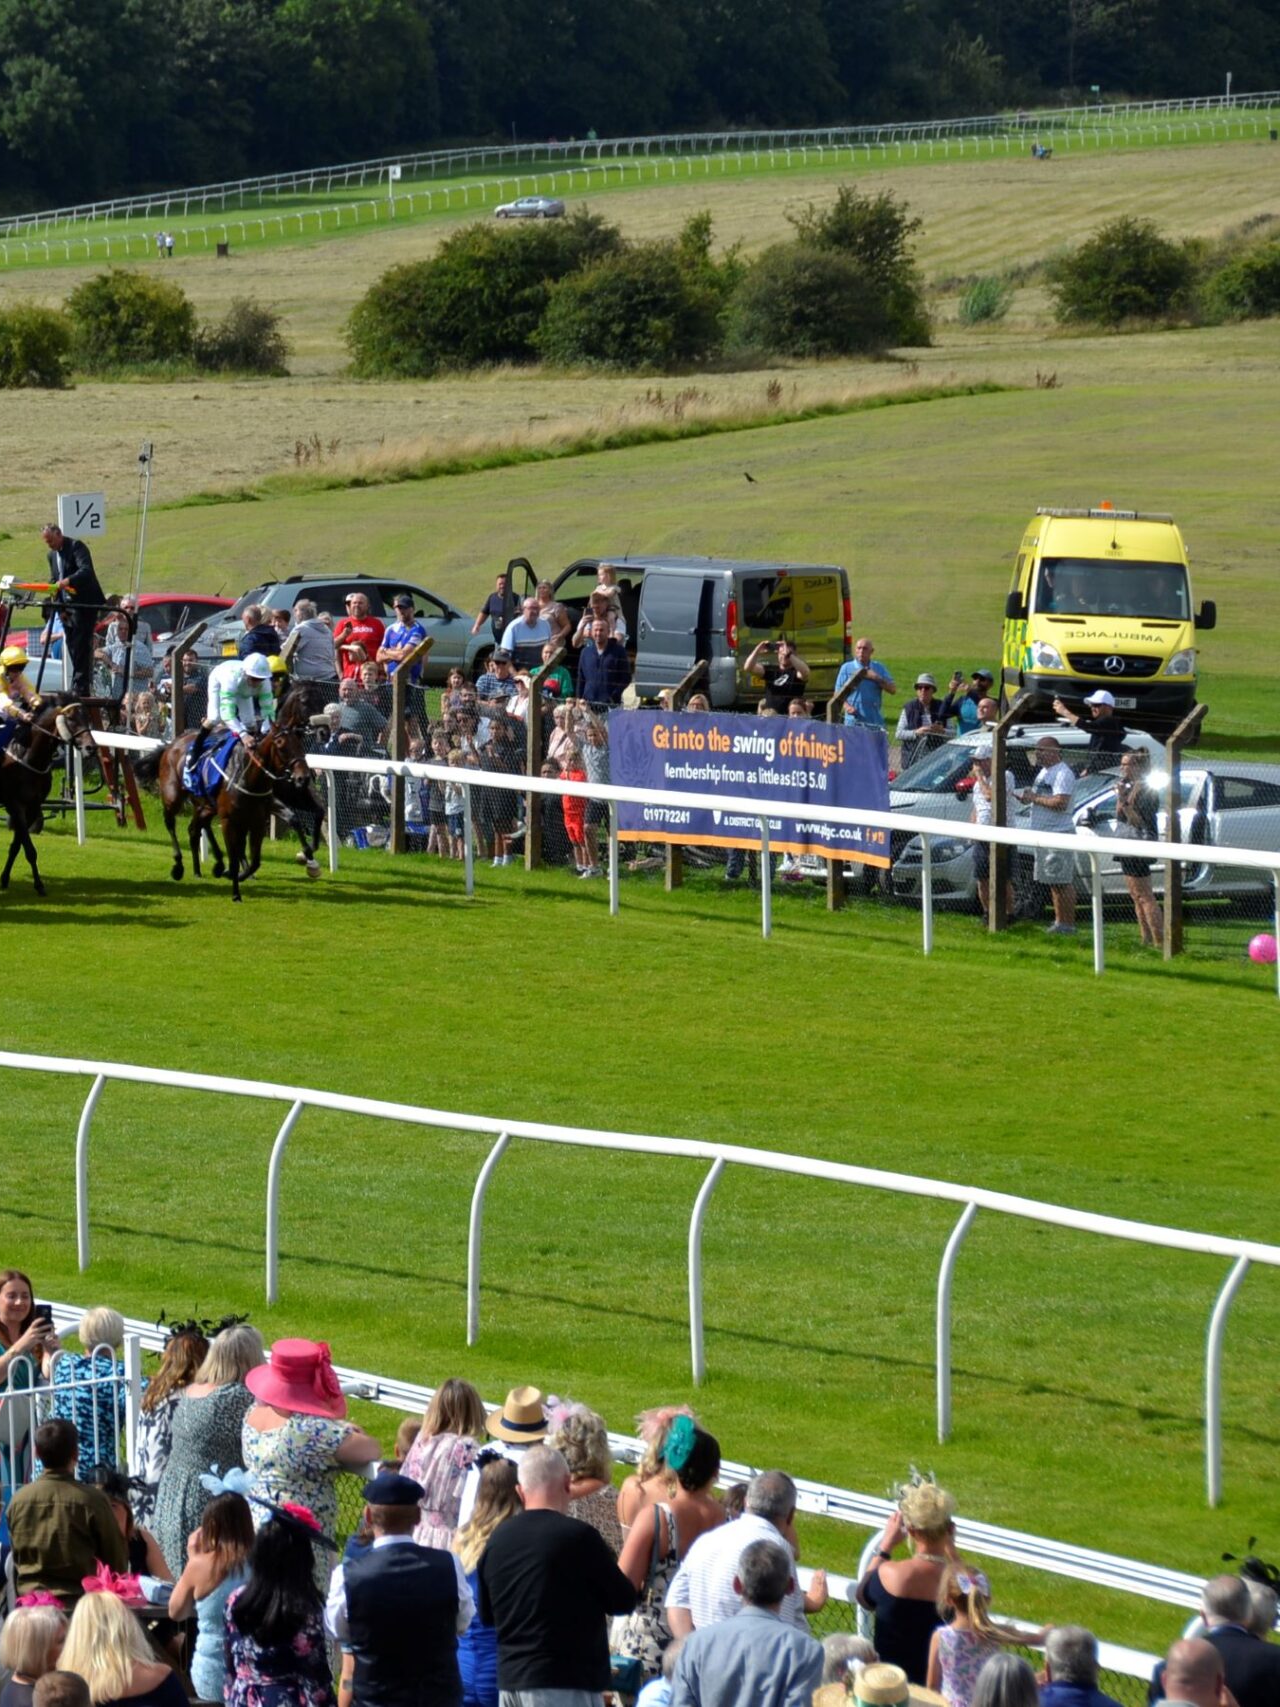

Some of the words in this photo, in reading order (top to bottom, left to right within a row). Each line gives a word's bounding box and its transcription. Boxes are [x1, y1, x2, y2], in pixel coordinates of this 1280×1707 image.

[673, 725, 705, 751] into
[707, 726, 731, 752] the
[732, 730, 775, 762] swing
[780, 731, 793, 757] of
[795, 732, 844, 768] things!
[721, 764, 745, 782] from
[746, 771, 758, 783] as
[758, 767, 779, 785] little
[780, 773, 790, 786] as
